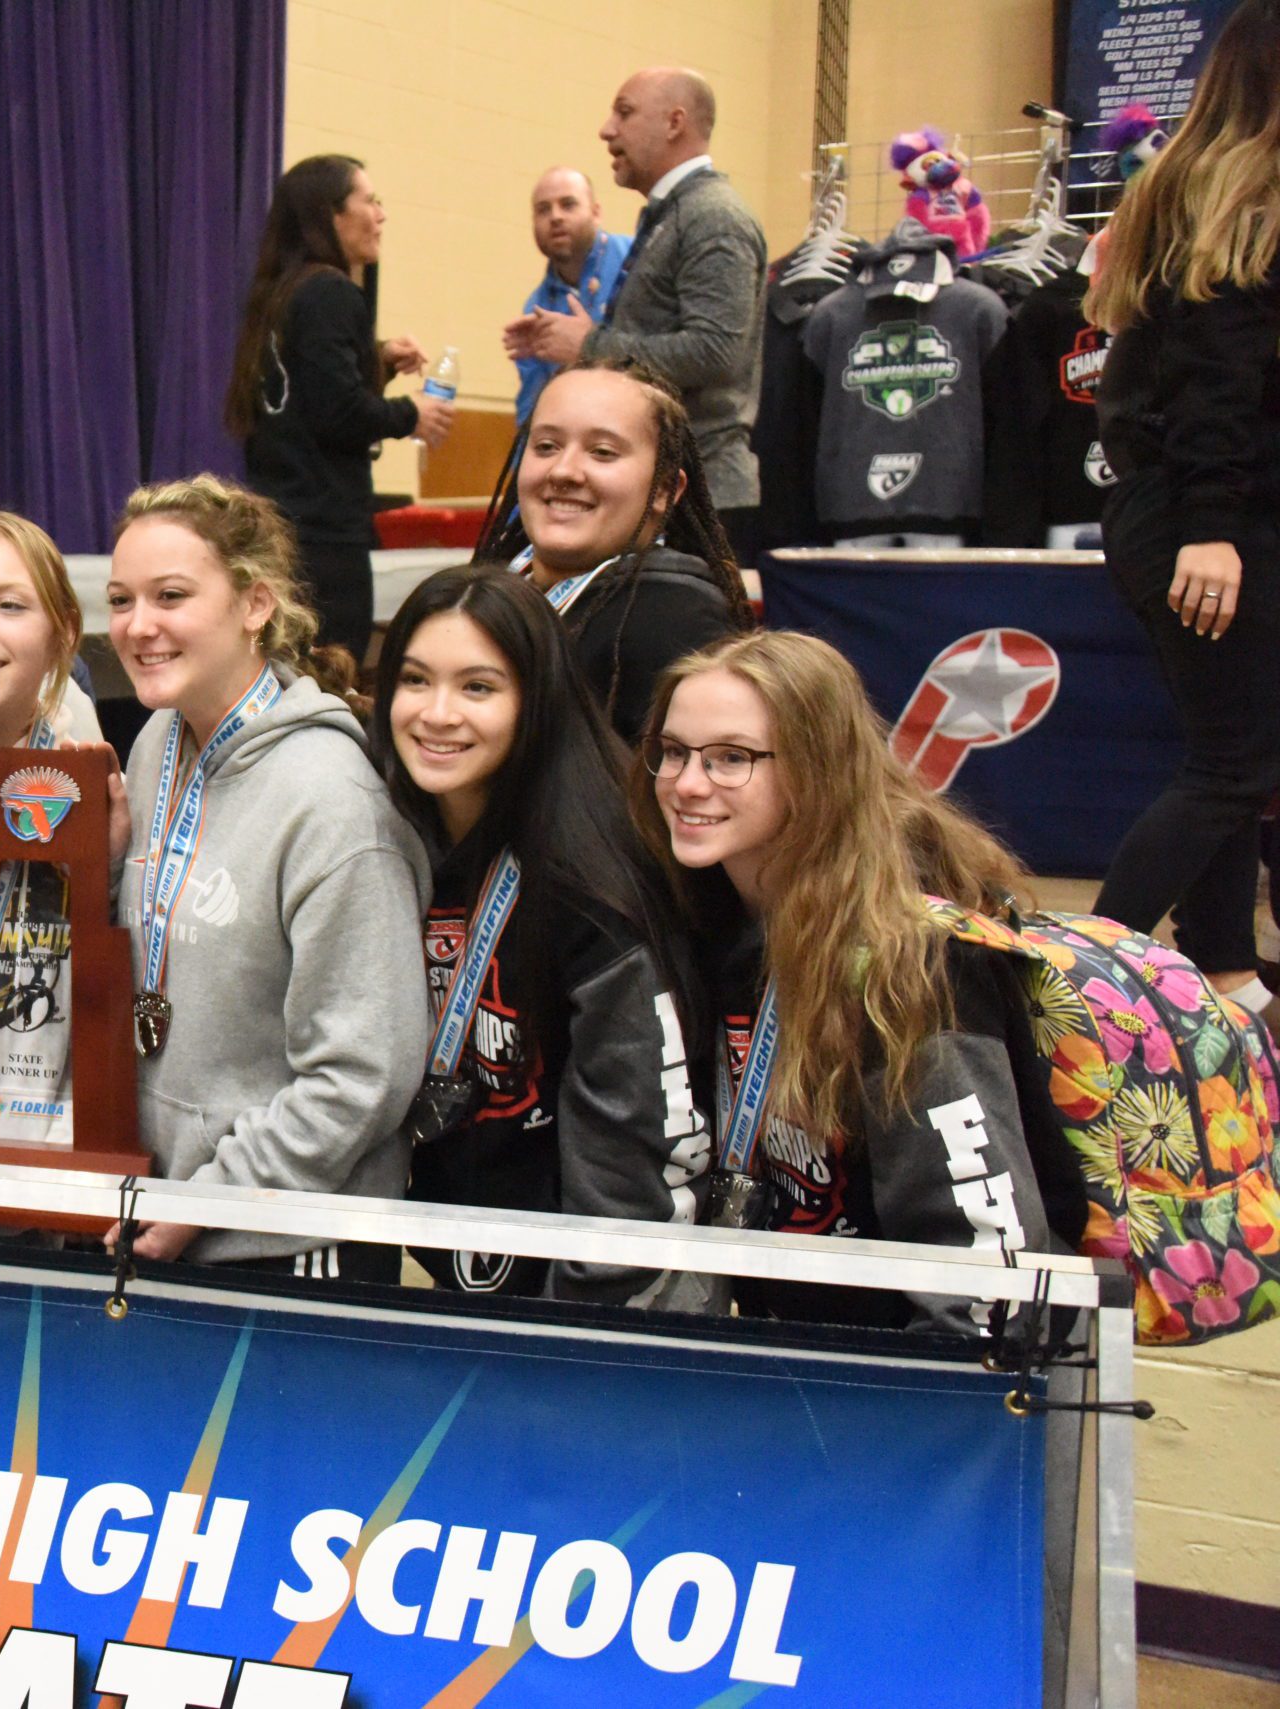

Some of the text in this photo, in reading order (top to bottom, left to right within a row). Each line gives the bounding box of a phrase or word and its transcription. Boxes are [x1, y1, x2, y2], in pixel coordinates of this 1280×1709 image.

[1133, 22, 1177, 35] JACKETS
[1098, 38, 1134, 49] FLEECE
[1135, 34, 1180, 47] JACKETS
[455, 864, 520, 1019] WEIGHTLIFTING
[8, 1053, 44, 1065] STATE
[43, 1069, 59, 1079] UP
[10, 1100, 64, 1115] FLORIDA
[272, 1507, 804, 1687] SCHOOL
